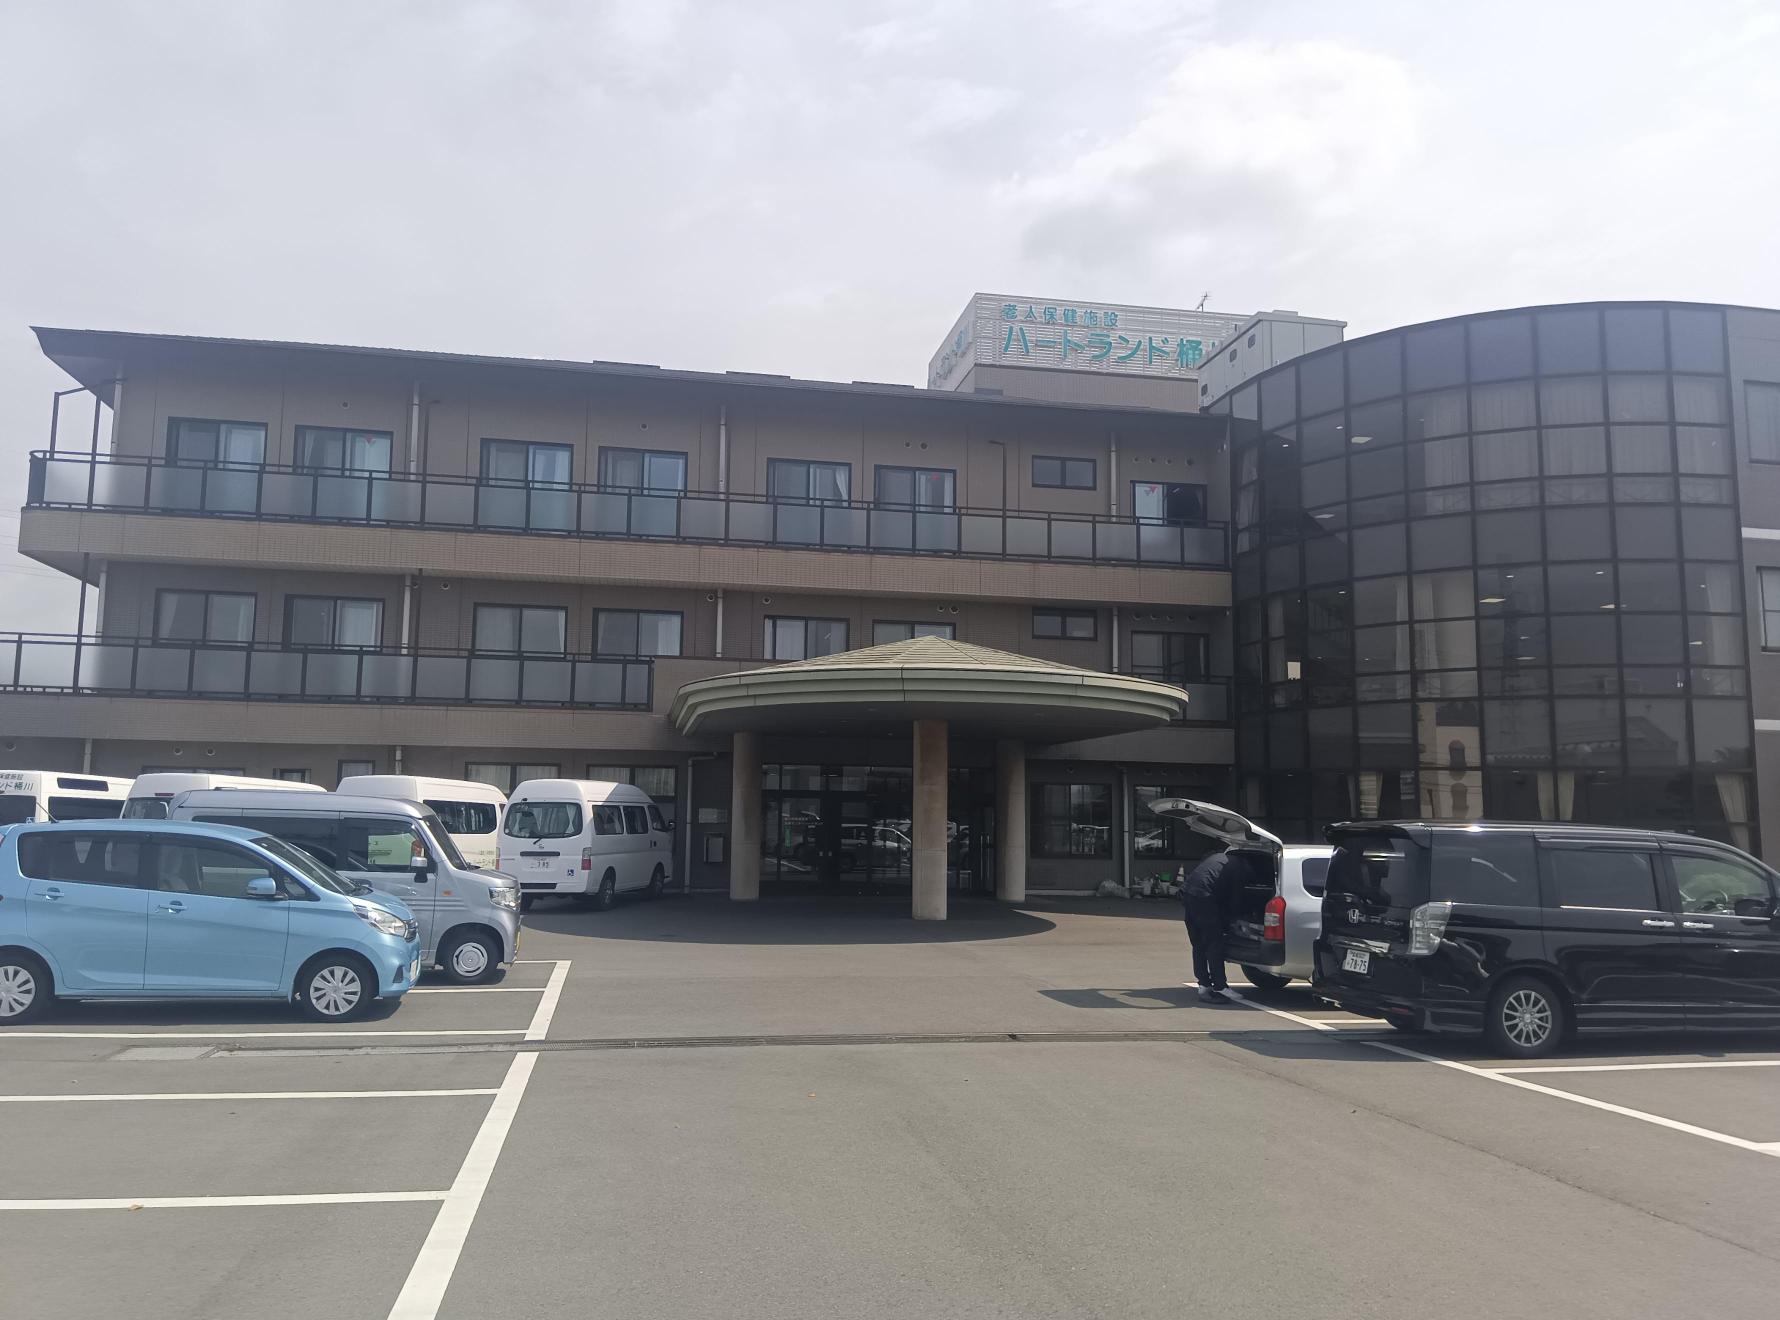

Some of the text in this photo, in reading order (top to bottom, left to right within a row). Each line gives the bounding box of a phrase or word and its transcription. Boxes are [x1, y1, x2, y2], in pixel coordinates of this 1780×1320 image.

[1001, 304, 1120, 328] 老人保健施設
[1003, 325, 1217, 368] ハートランド桶
